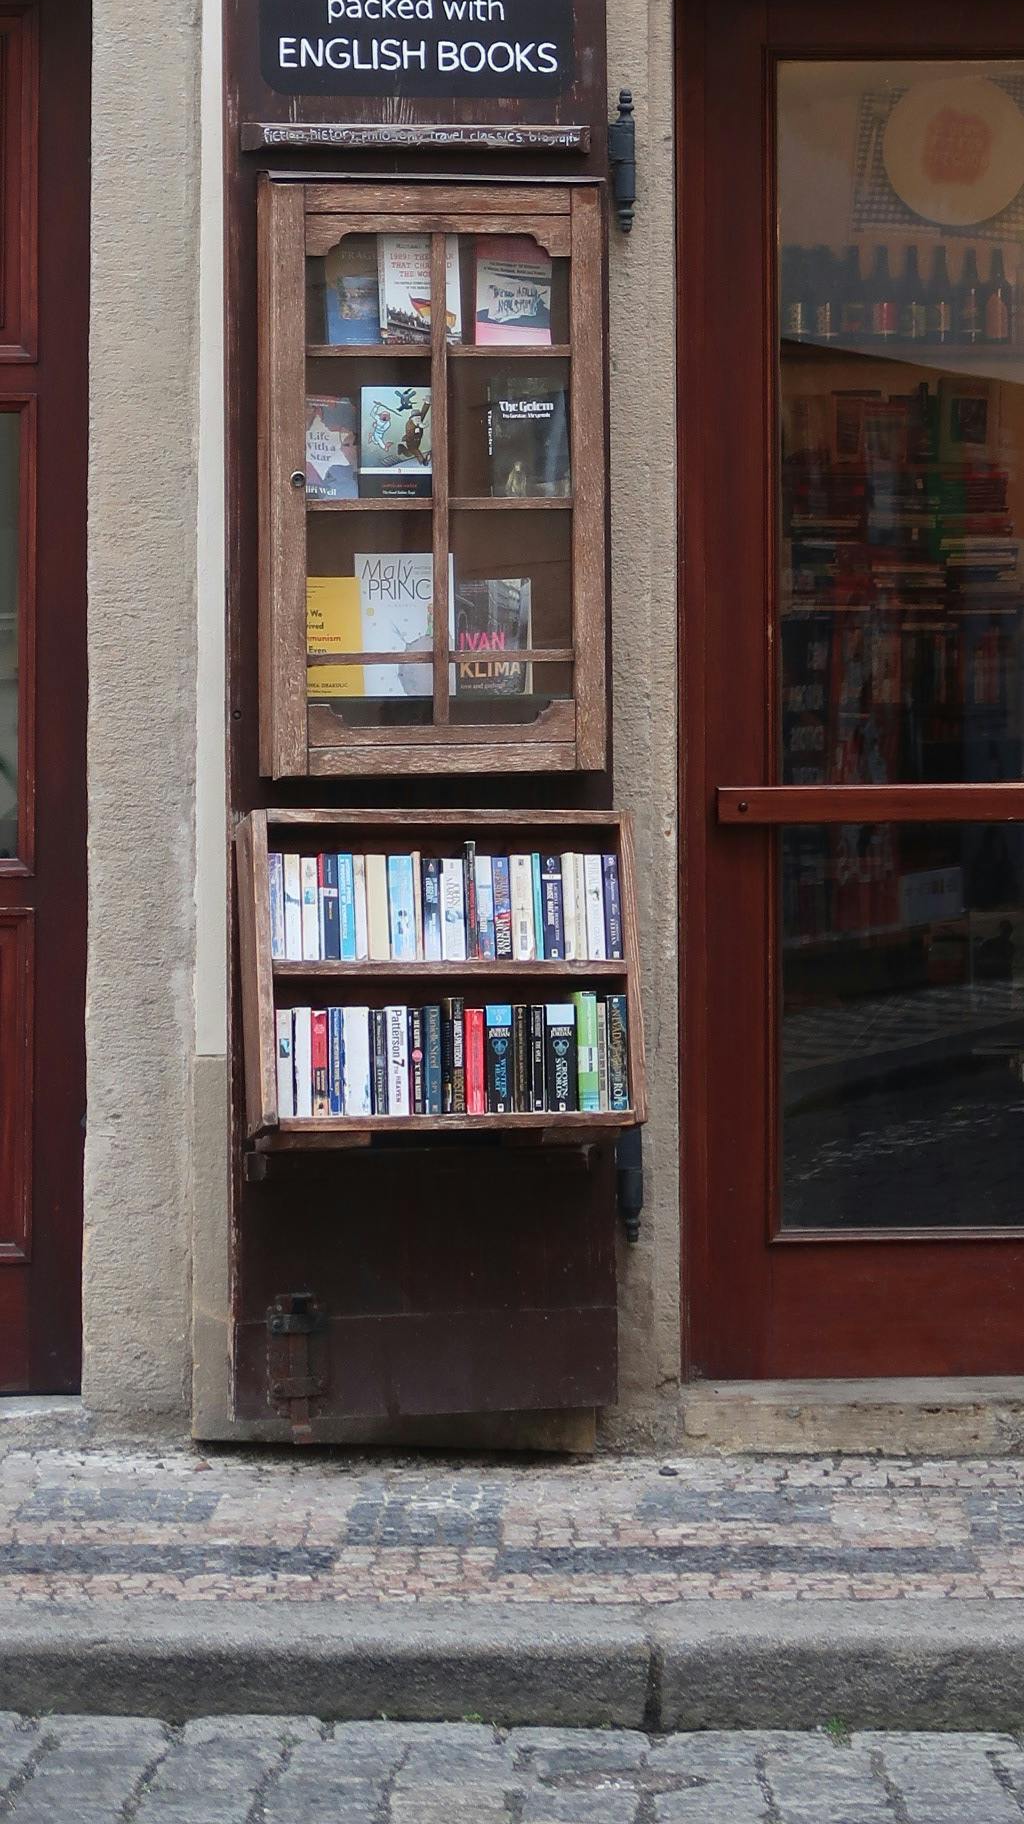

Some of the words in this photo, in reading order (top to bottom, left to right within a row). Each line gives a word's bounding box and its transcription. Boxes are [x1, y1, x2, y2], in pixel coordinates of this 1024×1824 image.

[279, 37, 426, 70] ENGLISH
[437, 40, 558, 73] BOOKS
[499, 401, 519, 412] The
[519, 401, 554, 412] Golem
[309, 431, 330, 441] Life
[361, 559, 414, 584] Malý
[368, 578, 432, 600] PRINC
[310, 609, 322, 618] We
[459, 631, 505, 651] IVAN
[460, 661, 521, 678] KLIMA
[495, 918, 505, 956] MURDER
[502, 918, 512, 954] CAPITOL
[391, 1009, 402, 1059] Patterson
[429, 1008, 440, 1044] Danielle
[611, 1009, 622, 1044] NEVADA
[430, 1044, 440, 1069] Steel
[612, 1082, 624, 1106] ROPE
